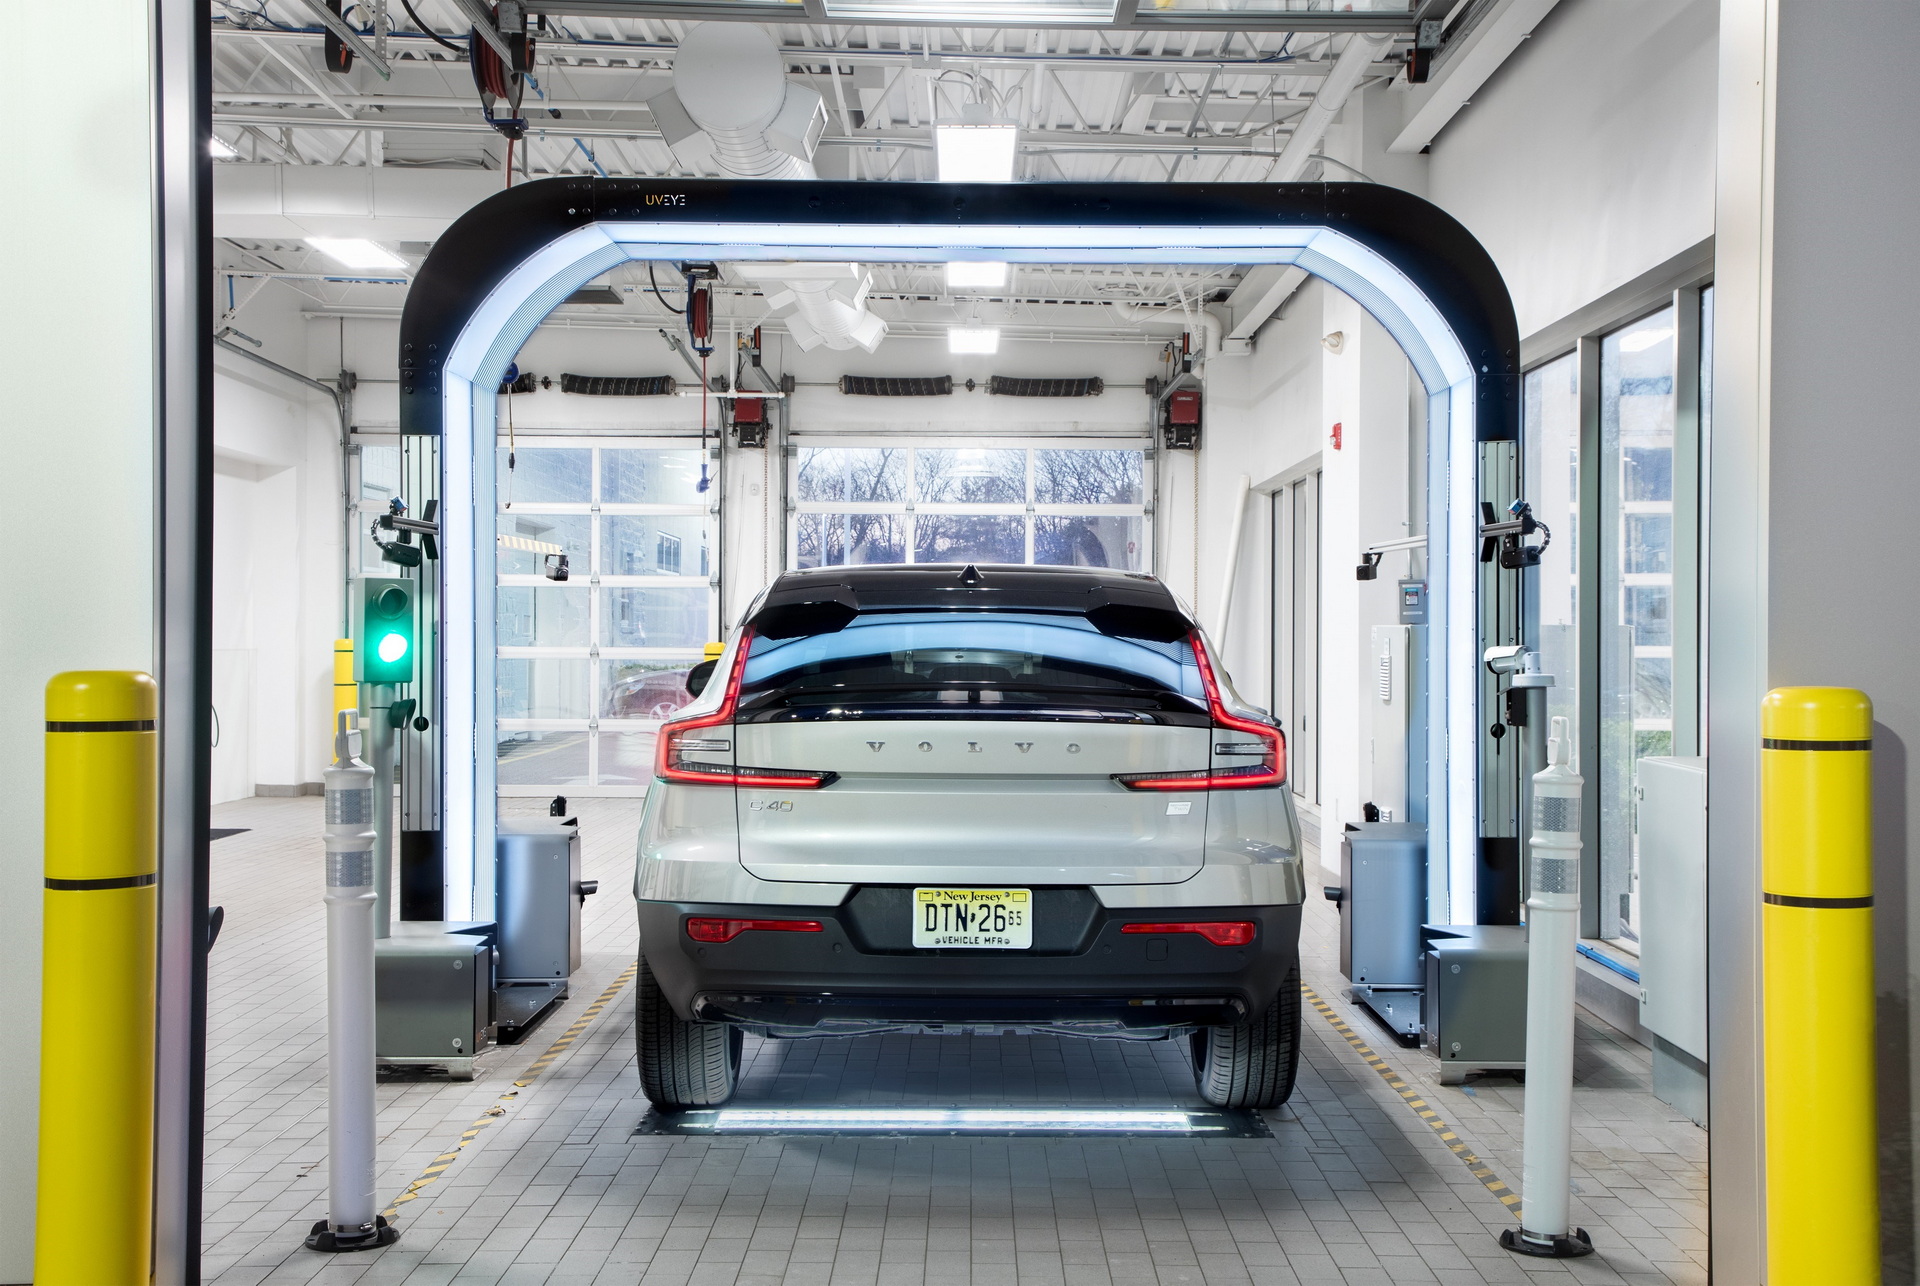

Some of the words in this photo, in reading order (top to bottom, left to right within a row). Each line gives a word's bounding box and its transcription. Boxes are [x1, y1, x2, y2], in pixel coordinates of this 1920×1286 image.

[866, 741, 1082, 754] VOLVO
[943, 891, 968, 901] New
[969, 891, 1002, 903] Jersey
[925, 903, 968, 932] DTN
[942, 936, 980, 945] VEHICLE
[984, 937, 1003, 945] MFR
